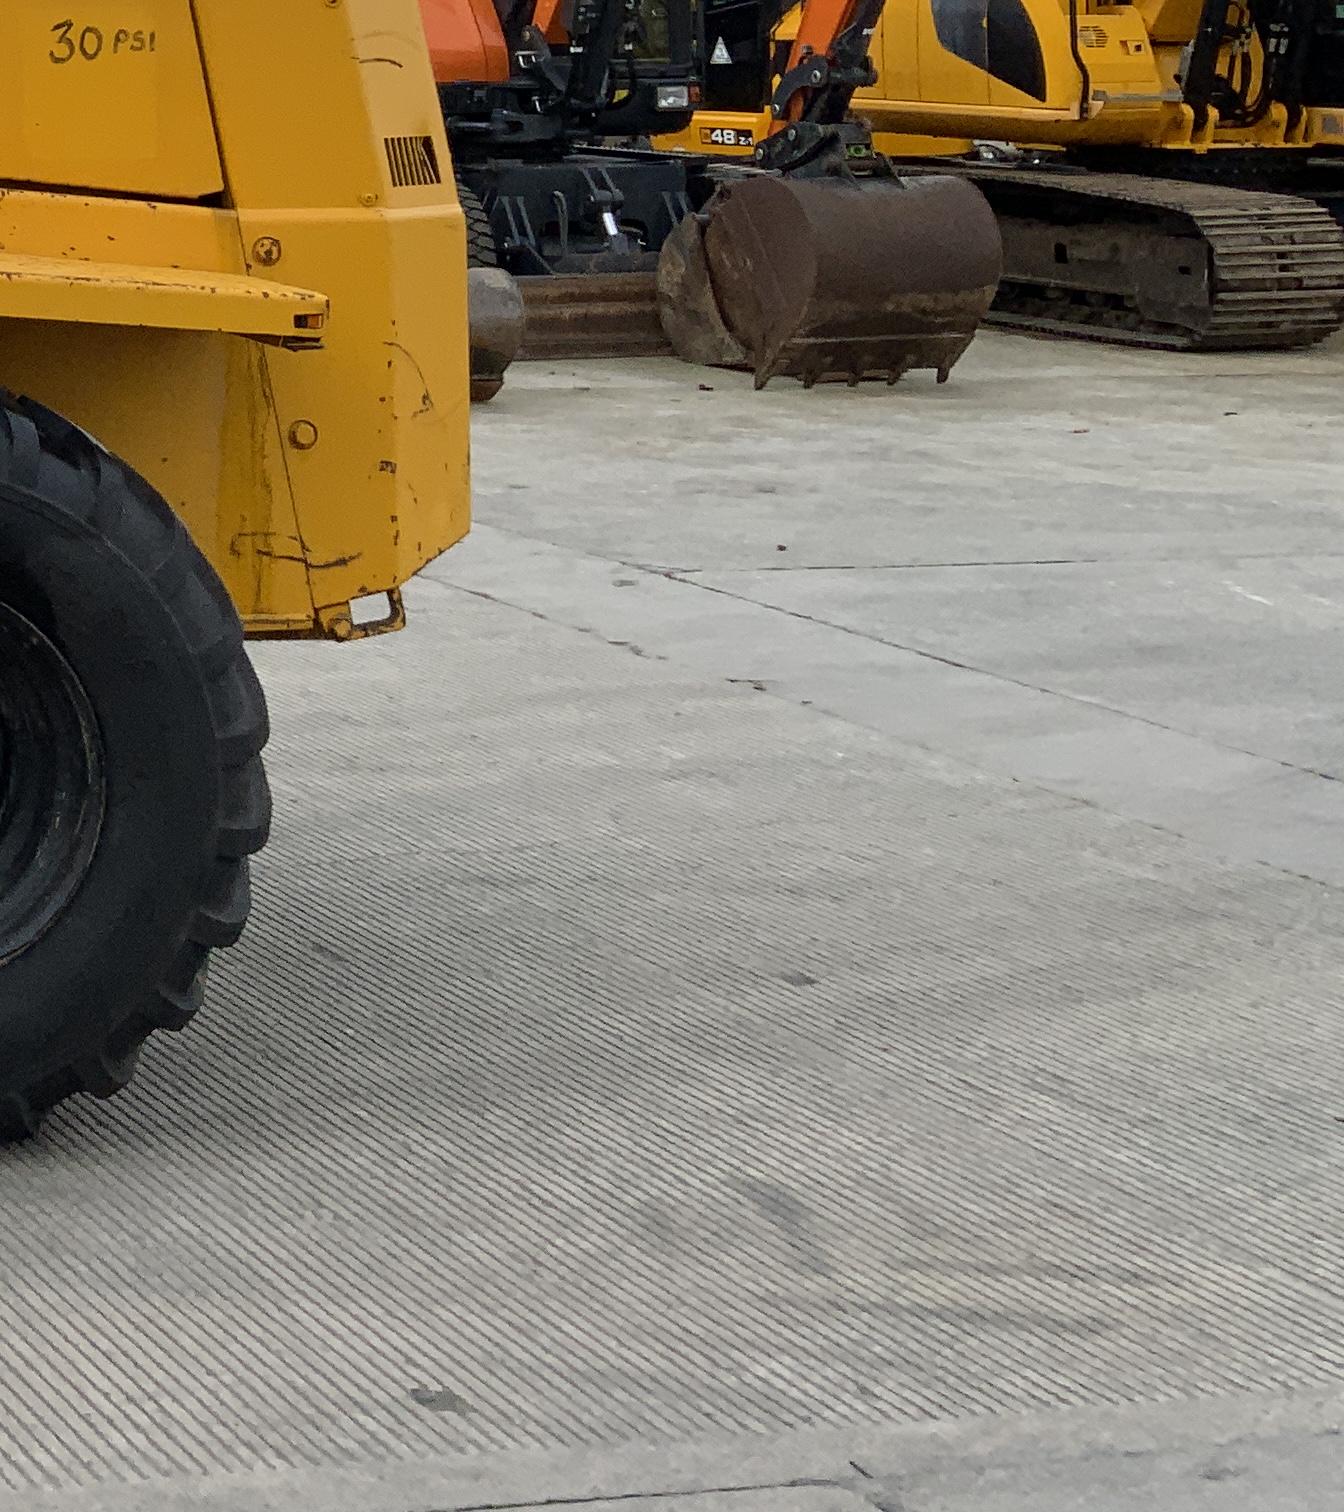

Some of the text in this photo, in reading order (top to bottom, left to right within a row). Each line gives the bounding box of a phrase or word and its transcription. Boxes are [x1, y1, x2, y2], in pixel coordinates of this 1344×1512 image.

[49, 19, 156, 64] 30 PSI
[711, 129, 735, 144] 48
